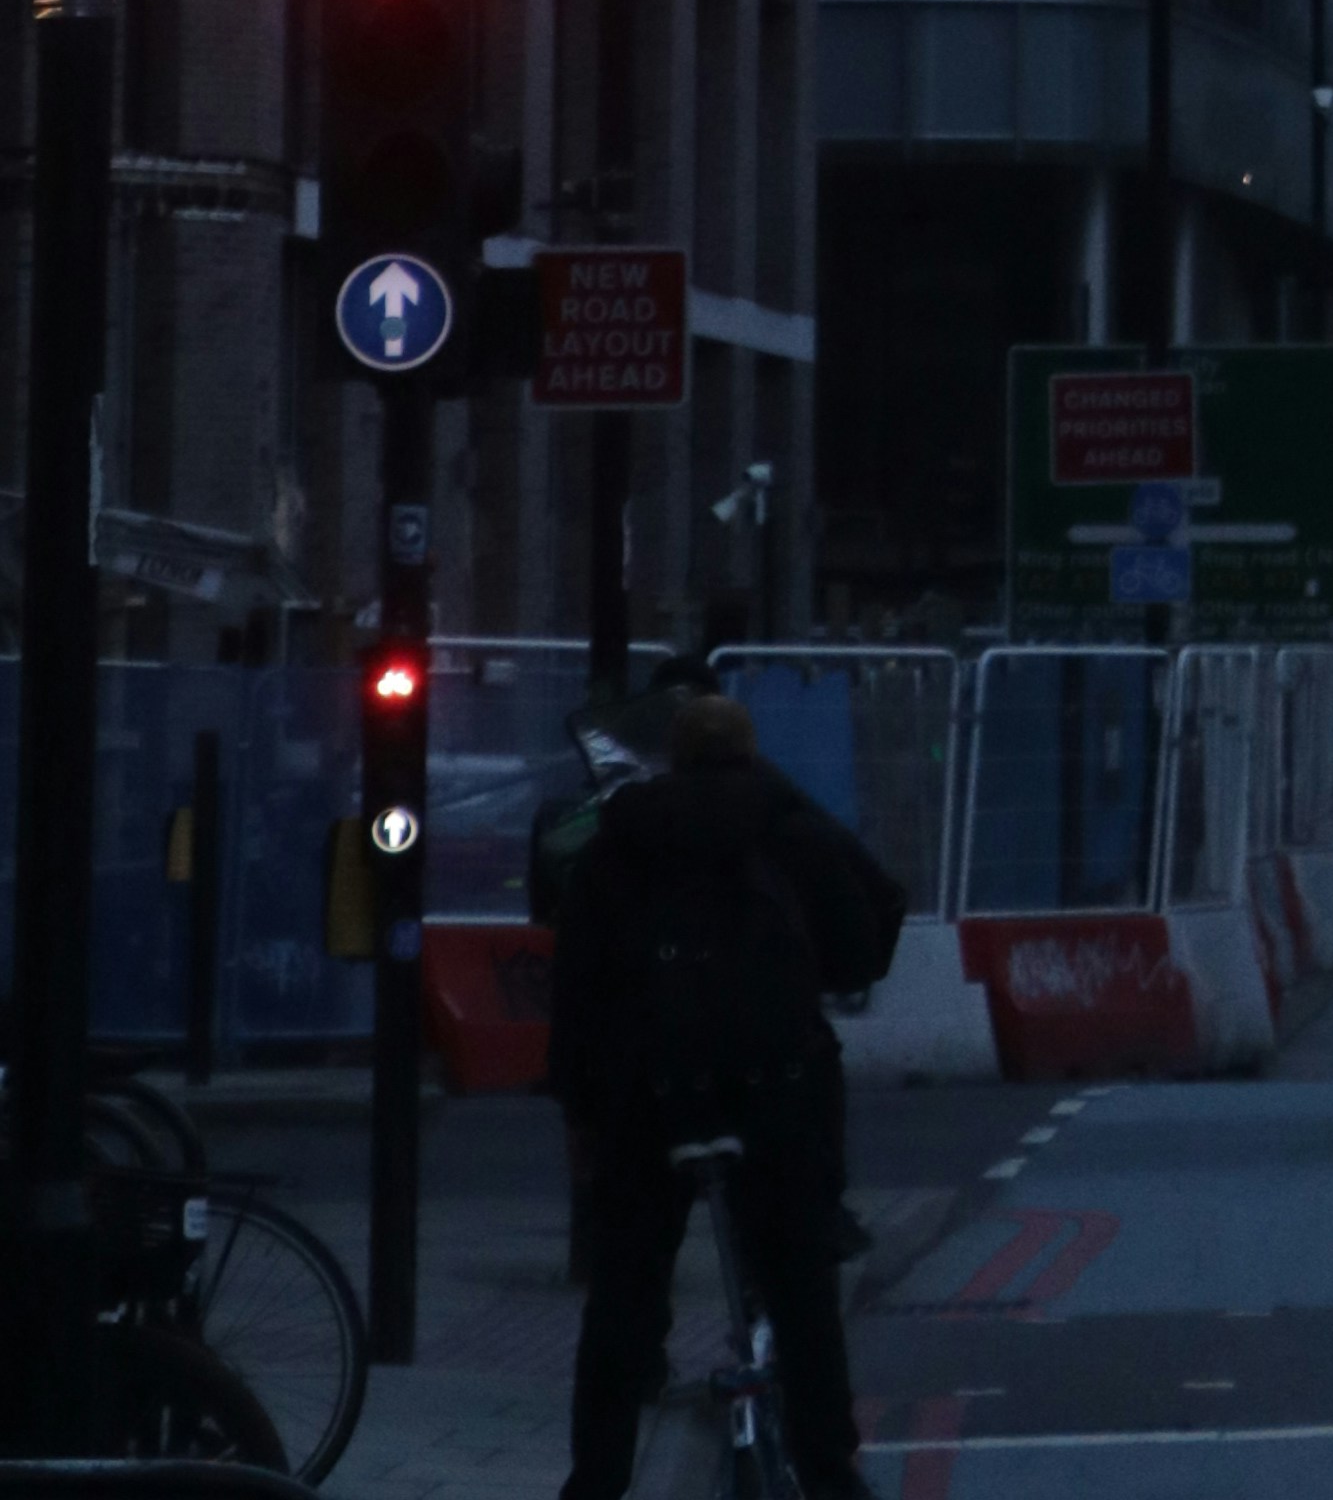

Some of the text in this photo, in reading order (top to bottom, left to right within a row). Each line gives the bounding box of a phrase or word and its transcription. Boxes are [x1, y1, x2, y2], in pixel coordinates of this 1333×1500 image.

[569, 261, 648, 291] NEW
[560, 296, 657, 324] ROAD
[543, 329, 674, 358] LAYOUT
[547, 363, 667, 392] AHEAD
[1063, 387, 1181, 410] CHANGED
[1059, 415, 1188, 439] PRIORITIES
[1083, 445, 1164, 468] AHEAD
